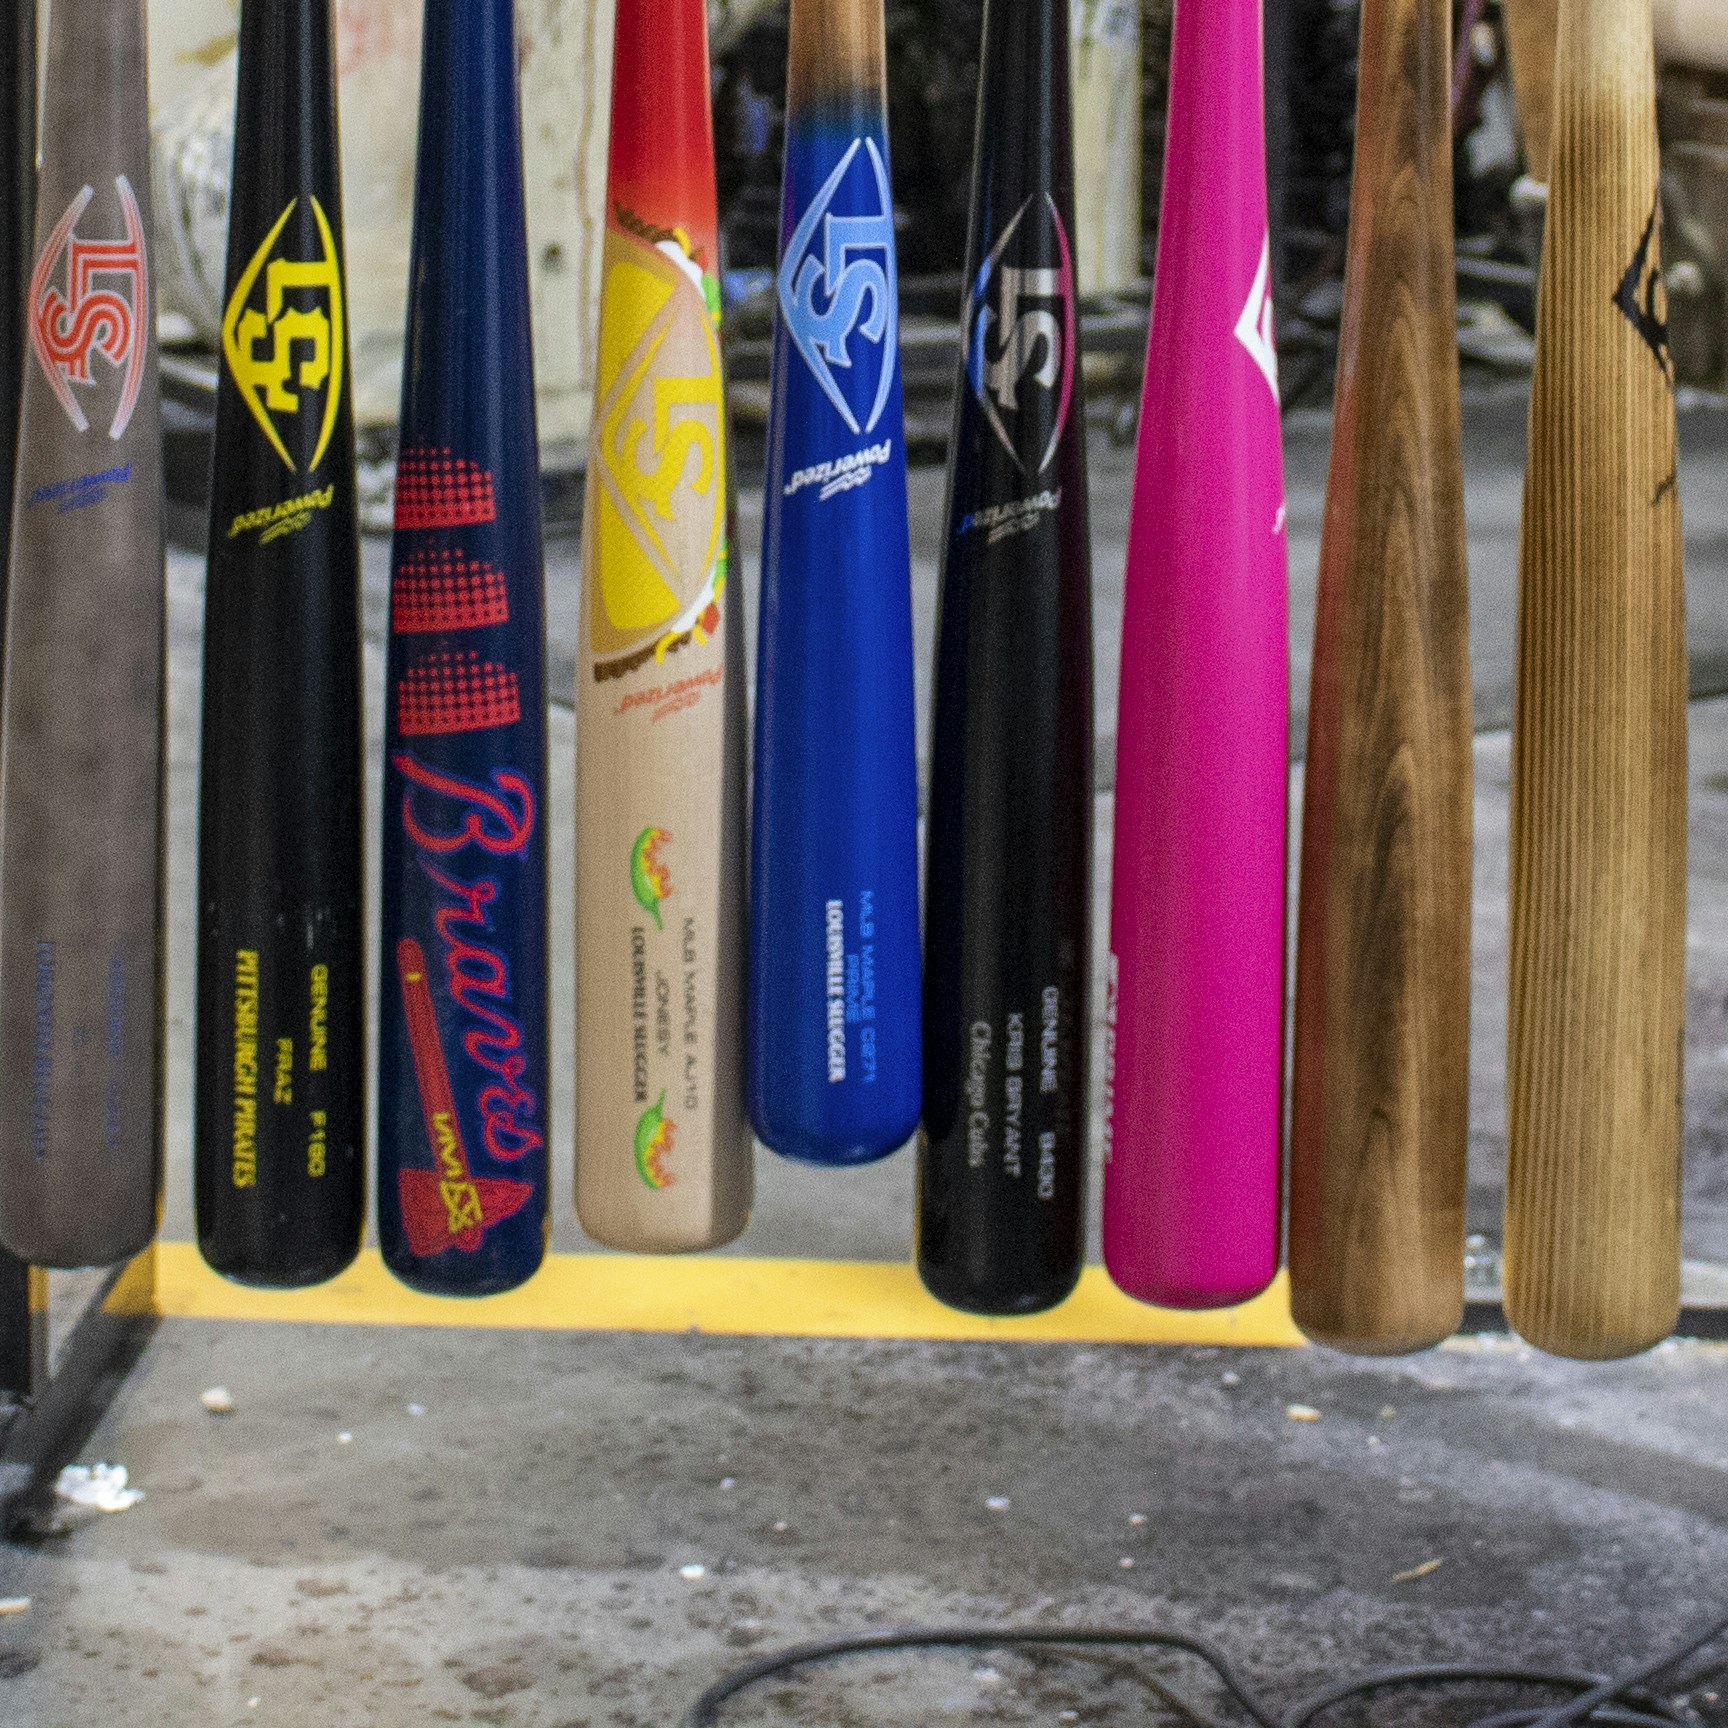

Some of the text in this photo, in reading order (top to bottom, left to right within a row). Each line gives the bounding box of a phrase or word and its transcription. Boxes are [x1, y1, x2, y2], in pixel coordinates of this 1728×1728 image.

[38, 240, 140, 384] LS
[233, 260, 330, 413] LS
[793, 213, 888, 367] LS
[968, 265, 1063, 409] LS
[616, 374, 722, 521] LS
[785, 437, 893, 497] Powerized
[390, 751, 545, 1165] Braves
[681, 917, 696, 964] MLB
[858, 889, 874, 938] MLB
[859, 944, 875, 1021] MAPLE
[308, 962, 328, 1071] GENUINE
[630, 925, 649, 1104] LOUISVILLE SLUGGER
[653, 969, 671, 1057] JONESY
[682, 970, 697, 1045] MAPLE
[824, 899, 845, 1084] LOUISVILLE SLUGGER
[1039, 985, 1058, 1093] GENUINE
[231, 948, 260, 1188] PITTSBURGH PIRATES
[272, 1036, 294, 1105] FRAZ
[963, 1019, 992, 1168] Chicago Cubs
[1002, 1011, 1023, 1178] KRIS BRYANT
